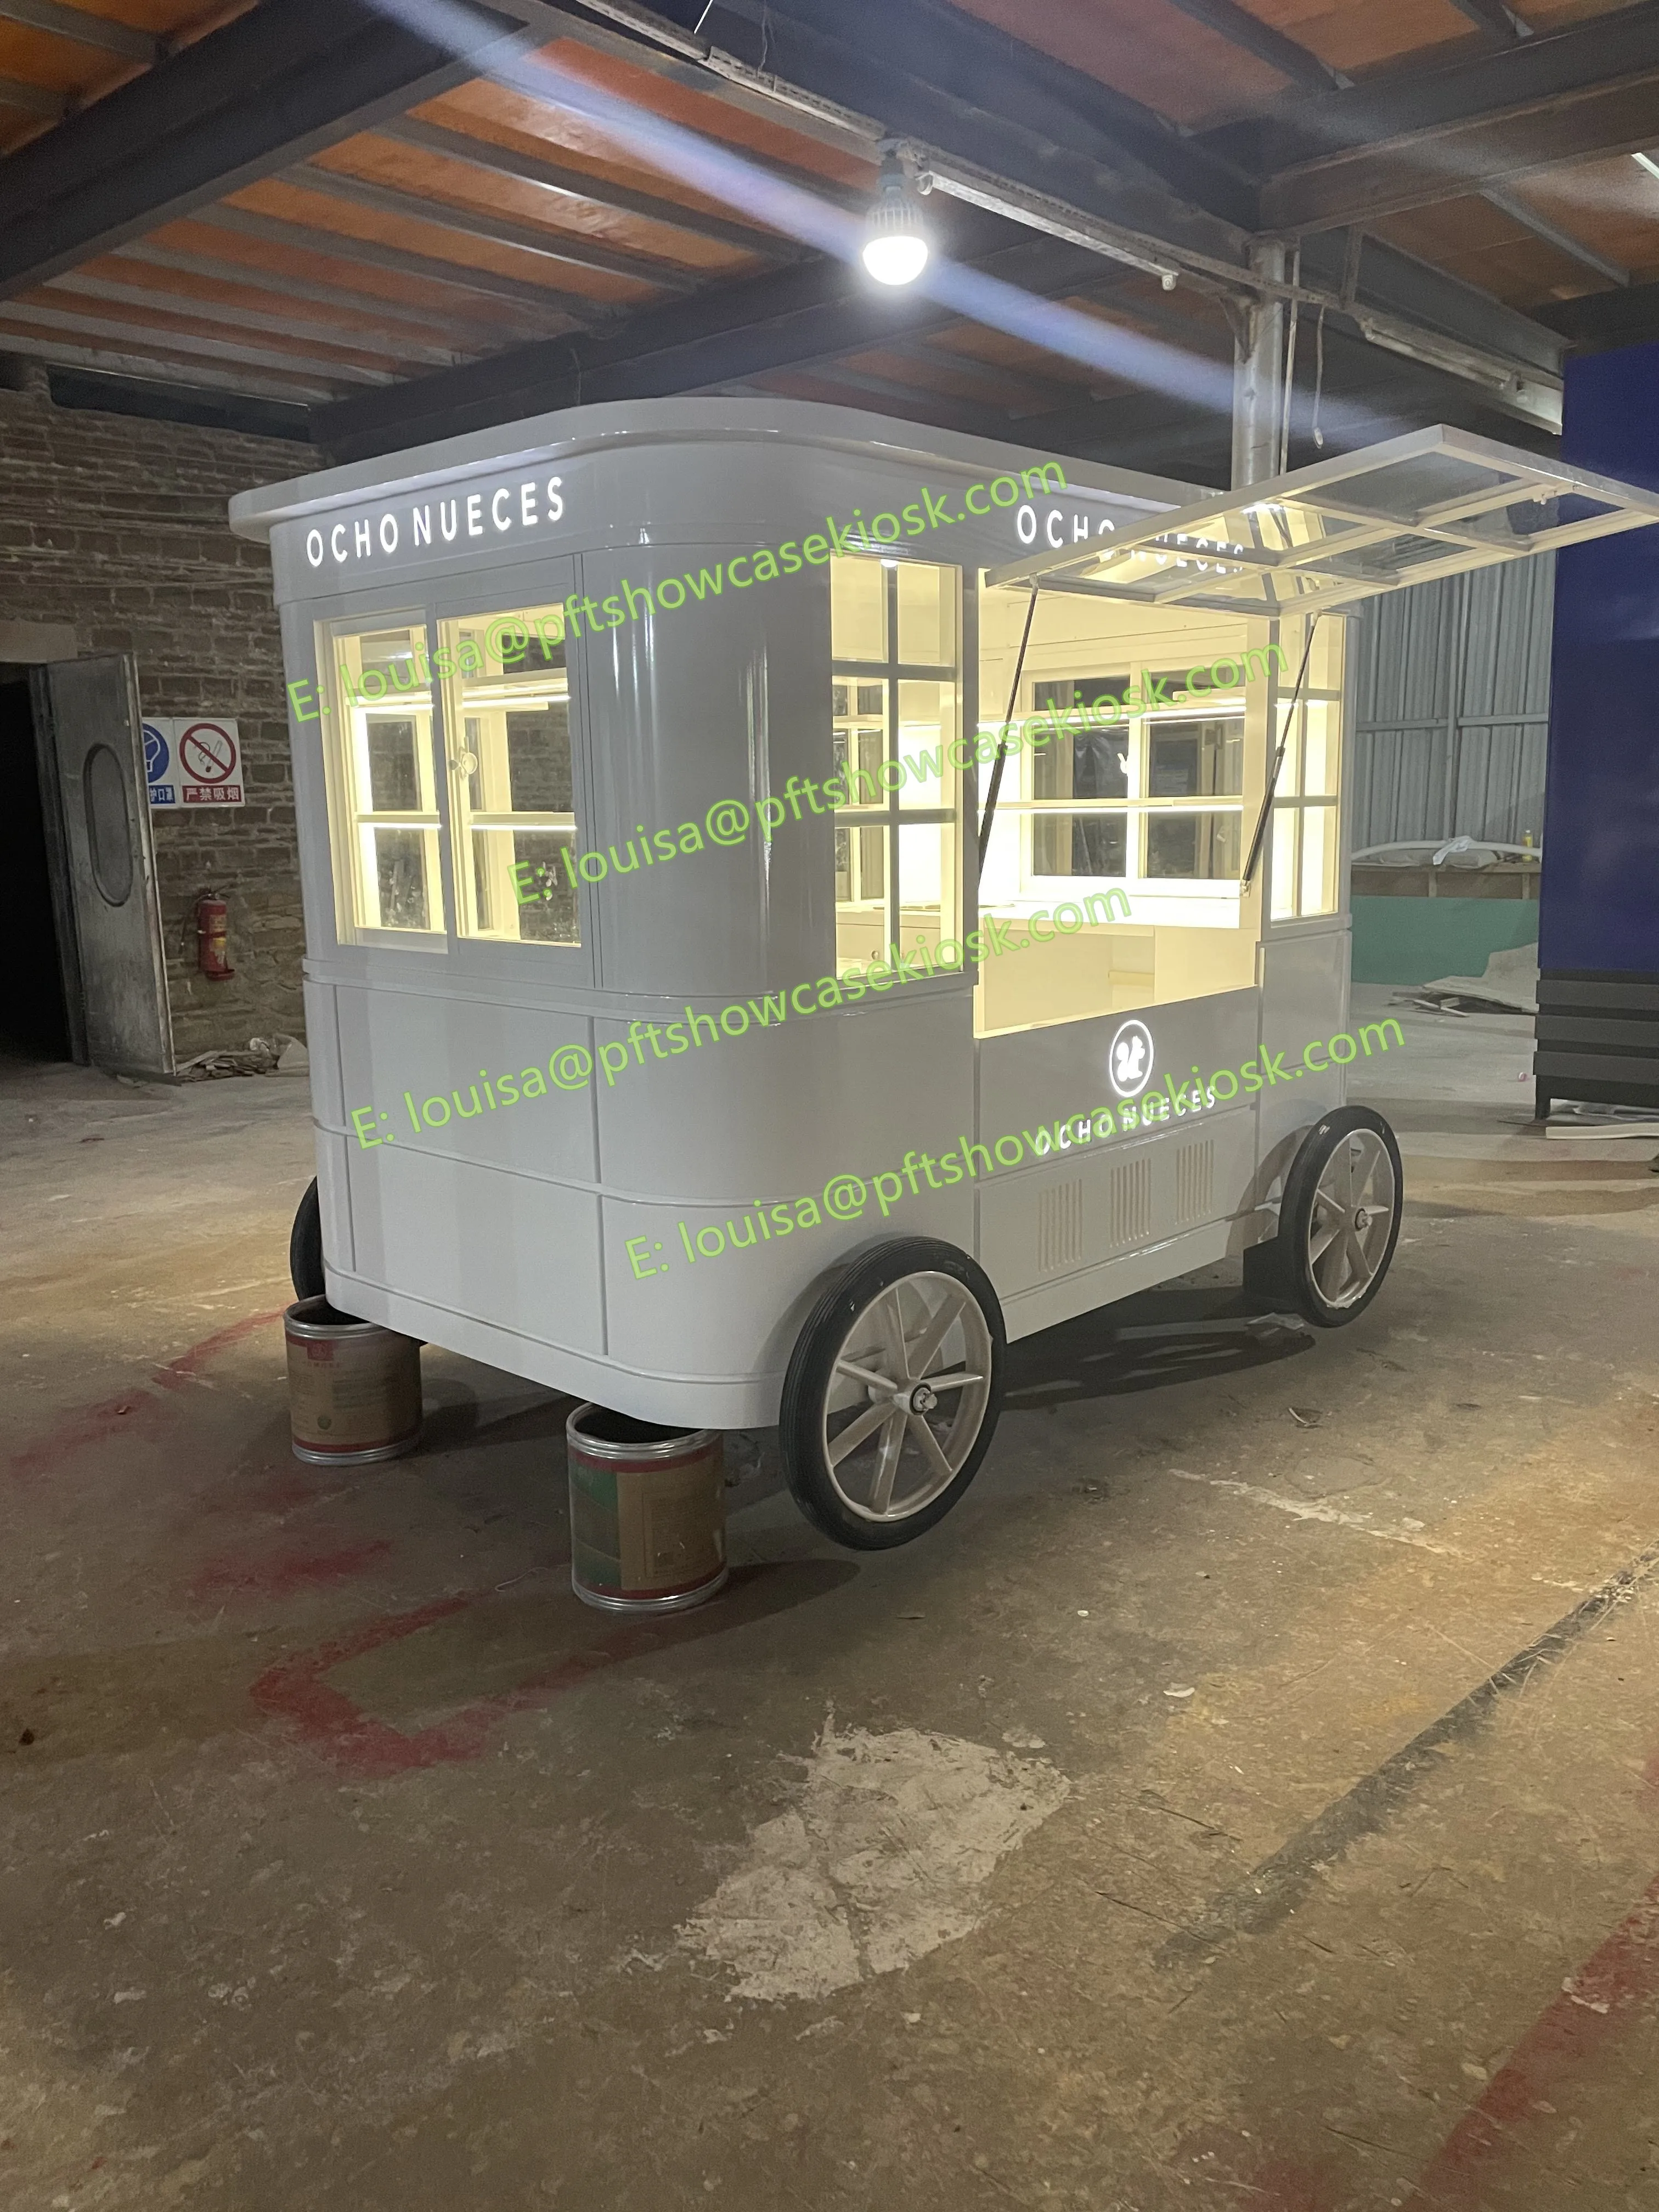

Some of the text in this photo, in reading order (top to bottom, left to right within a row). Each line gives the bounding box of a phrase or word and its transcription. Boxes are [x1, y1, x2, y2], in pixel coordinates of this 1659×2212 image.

[306, 476, 565, 567] OCHO NUECES
[186, 787, 239, 801] 严禁吸烟
[1035, 1085, 1216, 1155] OCHO NUECES
